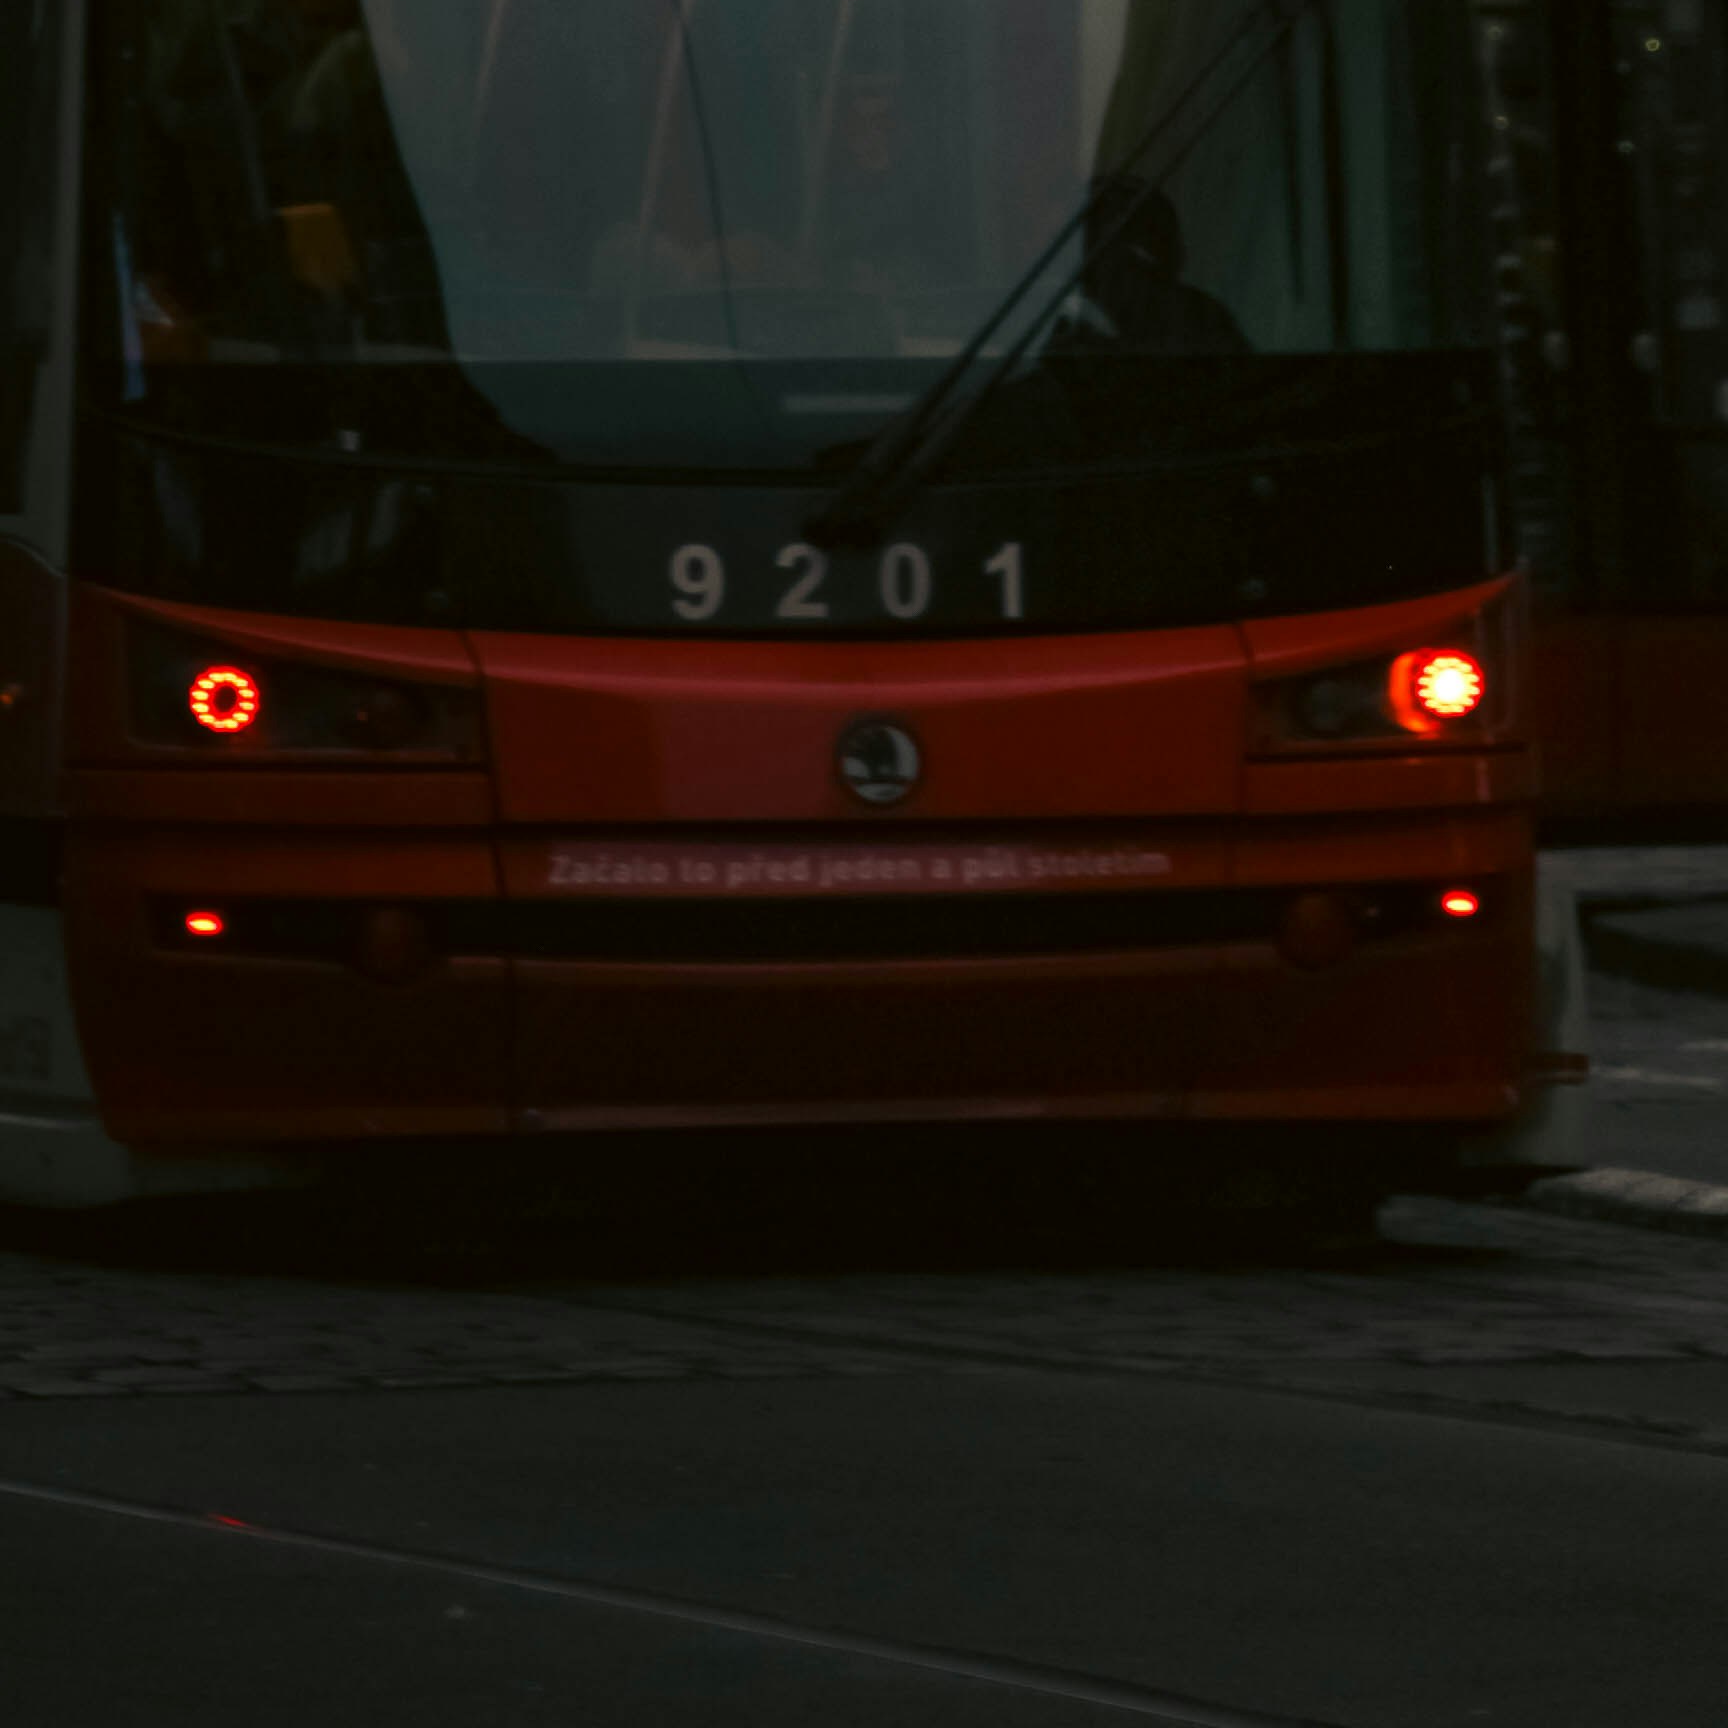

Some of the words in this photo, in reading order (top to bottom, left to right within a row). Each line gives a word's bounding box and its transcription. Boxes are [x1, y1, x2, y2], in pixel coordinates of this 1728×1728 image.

[667, 542, 1024, 621] 9201
[547, 851, 669, 886] Začalo
[679, 854, 716, 883] to
[724, 850, 809, 889] před
[817, 849, 919, 889] jeden
[930, 857, 952, 881] a
[961, 844, 1019, 885] půl
[1026, 846, 1171, 881] stoletím
